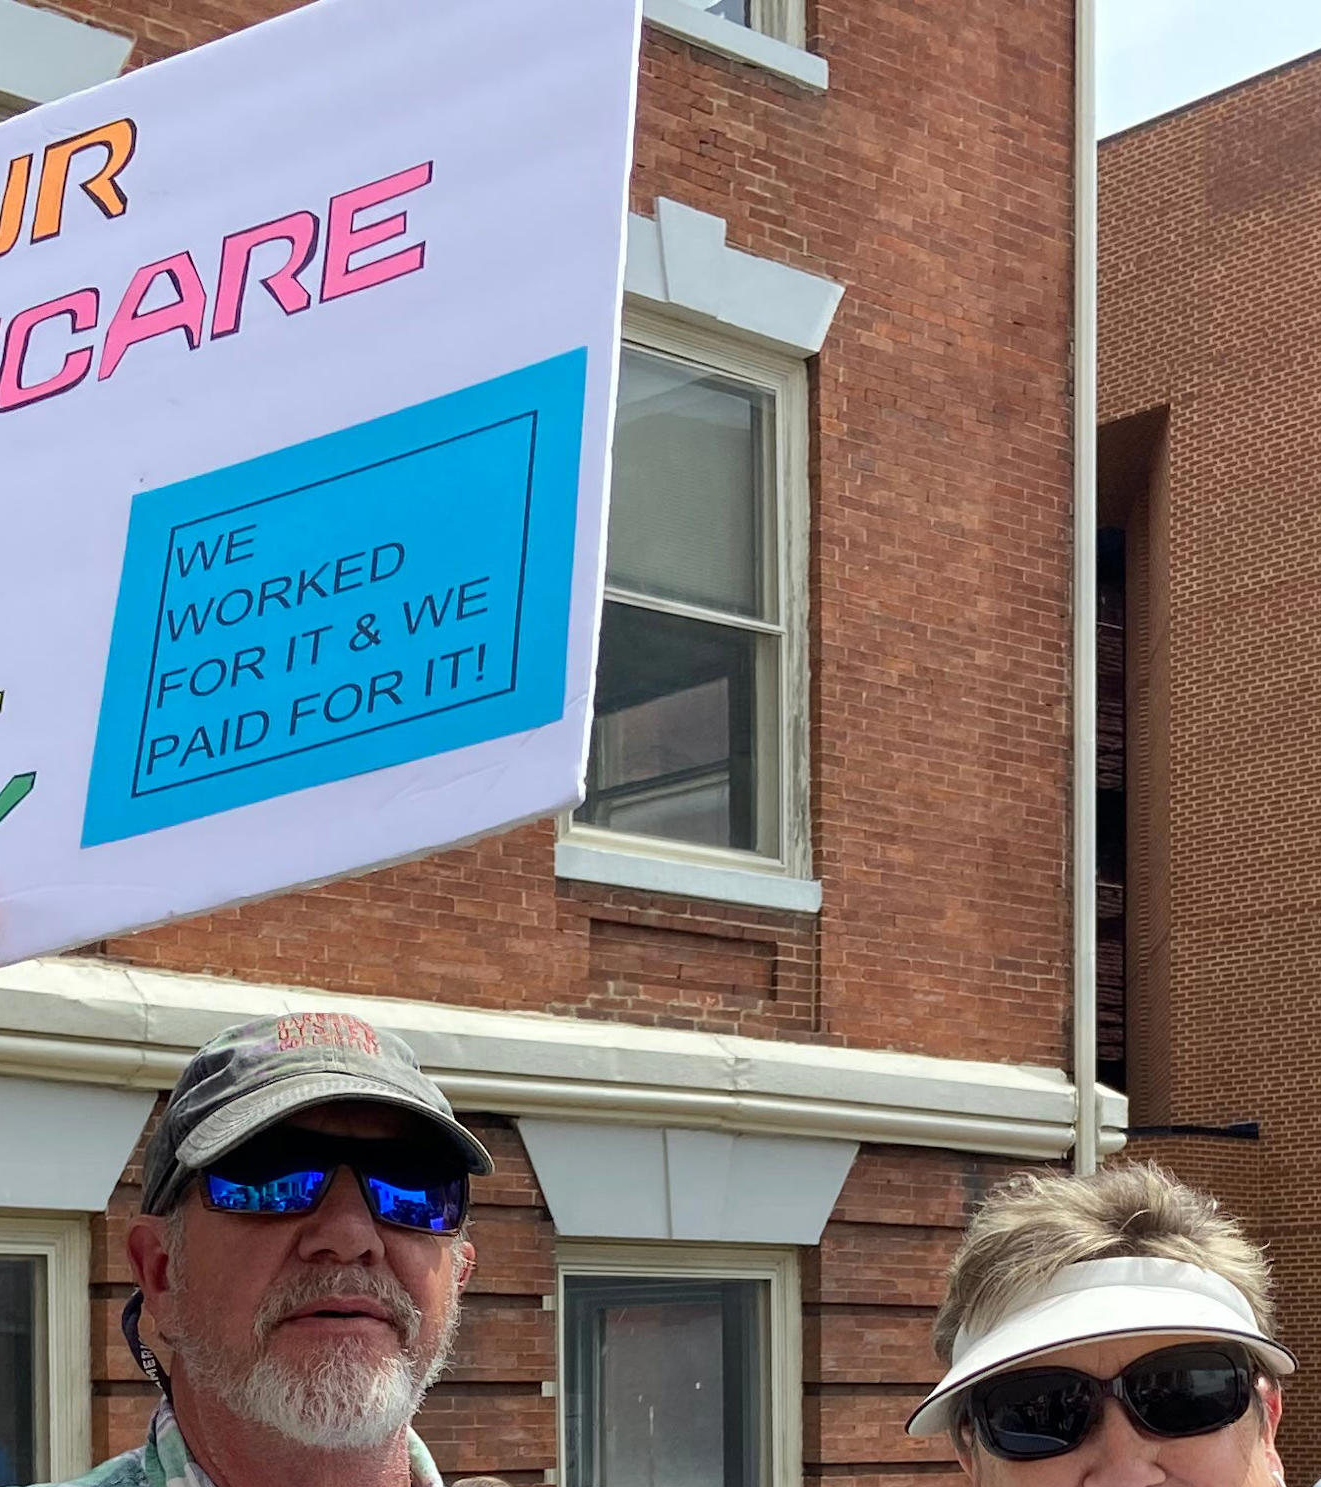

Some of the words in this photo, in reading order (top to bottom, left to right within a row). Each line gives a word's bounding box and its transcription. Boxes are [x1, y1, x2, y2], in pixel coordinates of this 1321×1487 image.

[166, 542, 405, 643] WORKED
[177, 524, 257, 578] WE
[157, 646, 266, 708] FOR
[286, 625, 333, 672] IT
[349, 613, 382, 652] &
[403, 577, 490, 635] WE
[146, 710, 270, 775] PAID
[289, 670, 403, 736] FOR
[425, 644, 487, 697] IT!
